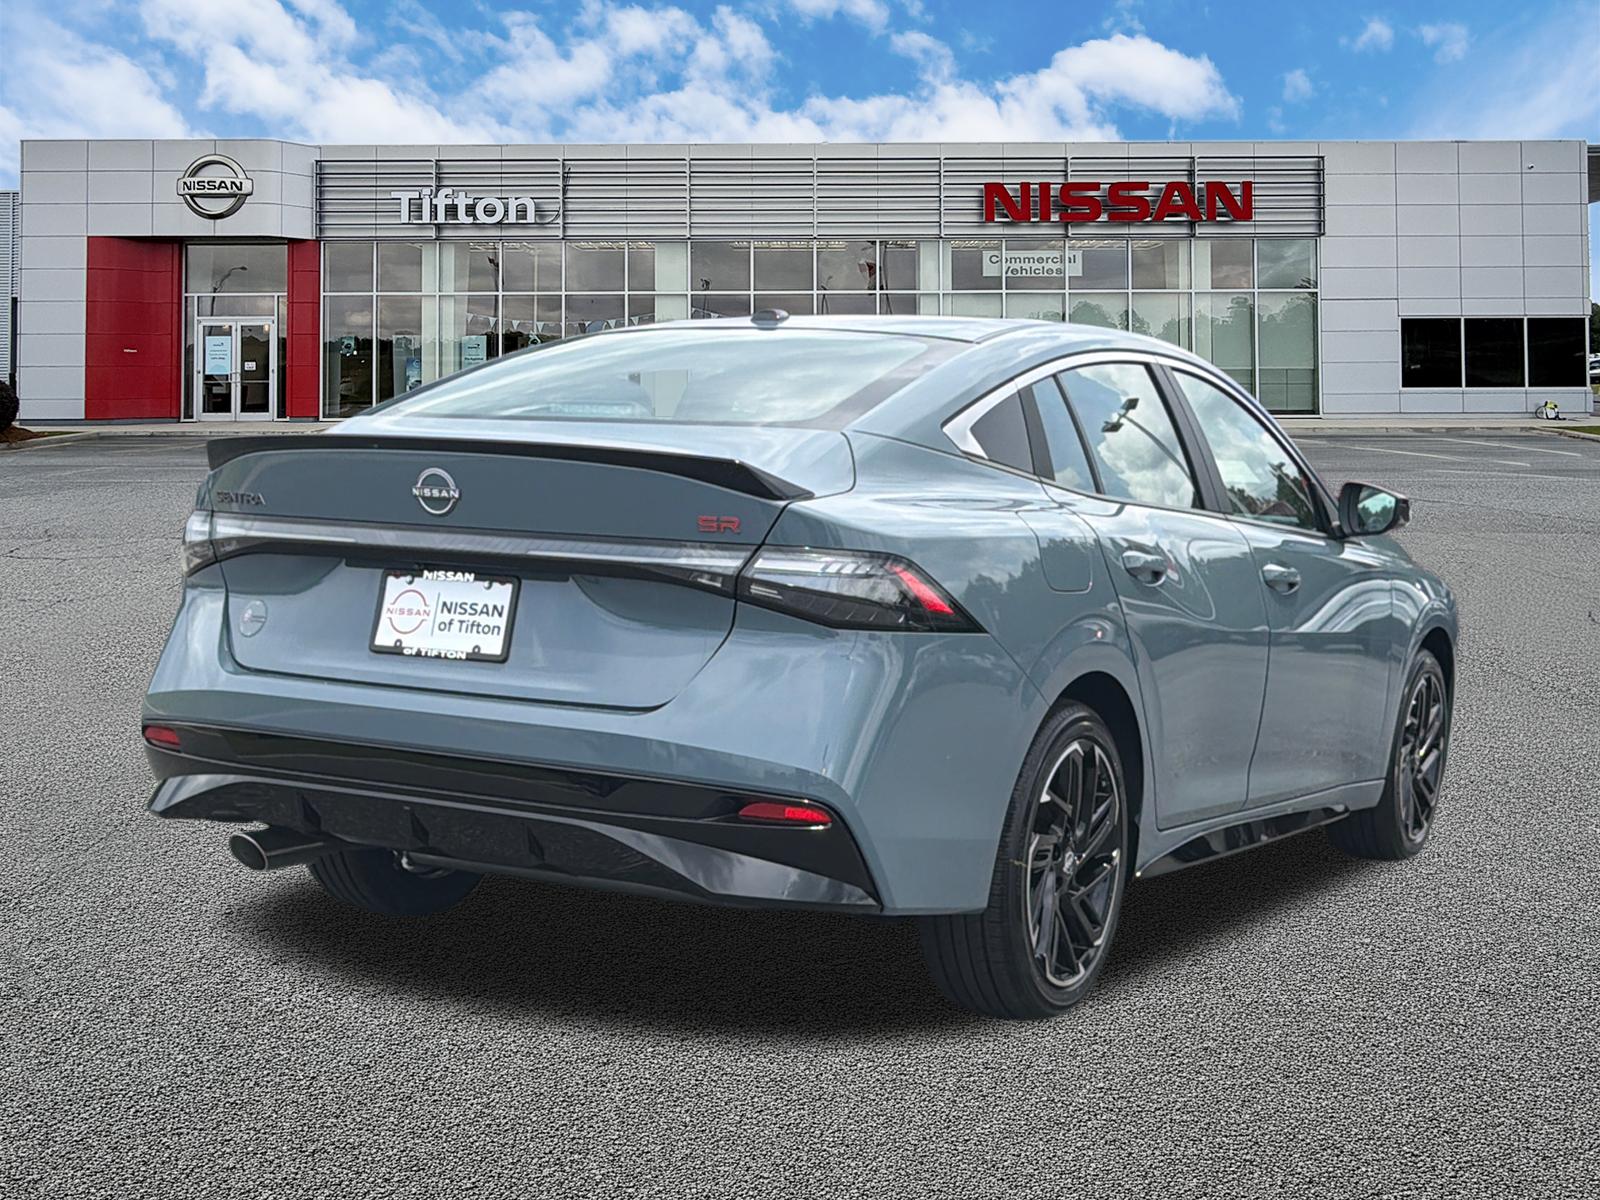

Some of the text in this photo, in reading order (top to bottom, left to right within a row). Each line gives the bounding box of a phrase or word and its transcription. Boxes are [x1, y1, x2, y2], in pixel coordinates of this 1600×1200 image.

[183, 180, 243, 191] NISSAN
[391, 188, 536, 224] Tifton
[984, 181, 1253, 222] NISSAN
[216, 491, 266, 505] SENTRA
[412, 487, 460, 499] NISSAN
[697, 515, 741, 534] SR
[422, 570, 475, 582] NISSAN
[386, 607, 431, 617] NISSAN
[440, 601, 505, 618] NISSAN
[438, 618, 501, 636] of Tifton
[418, 649, 467, 660] TIFTON
